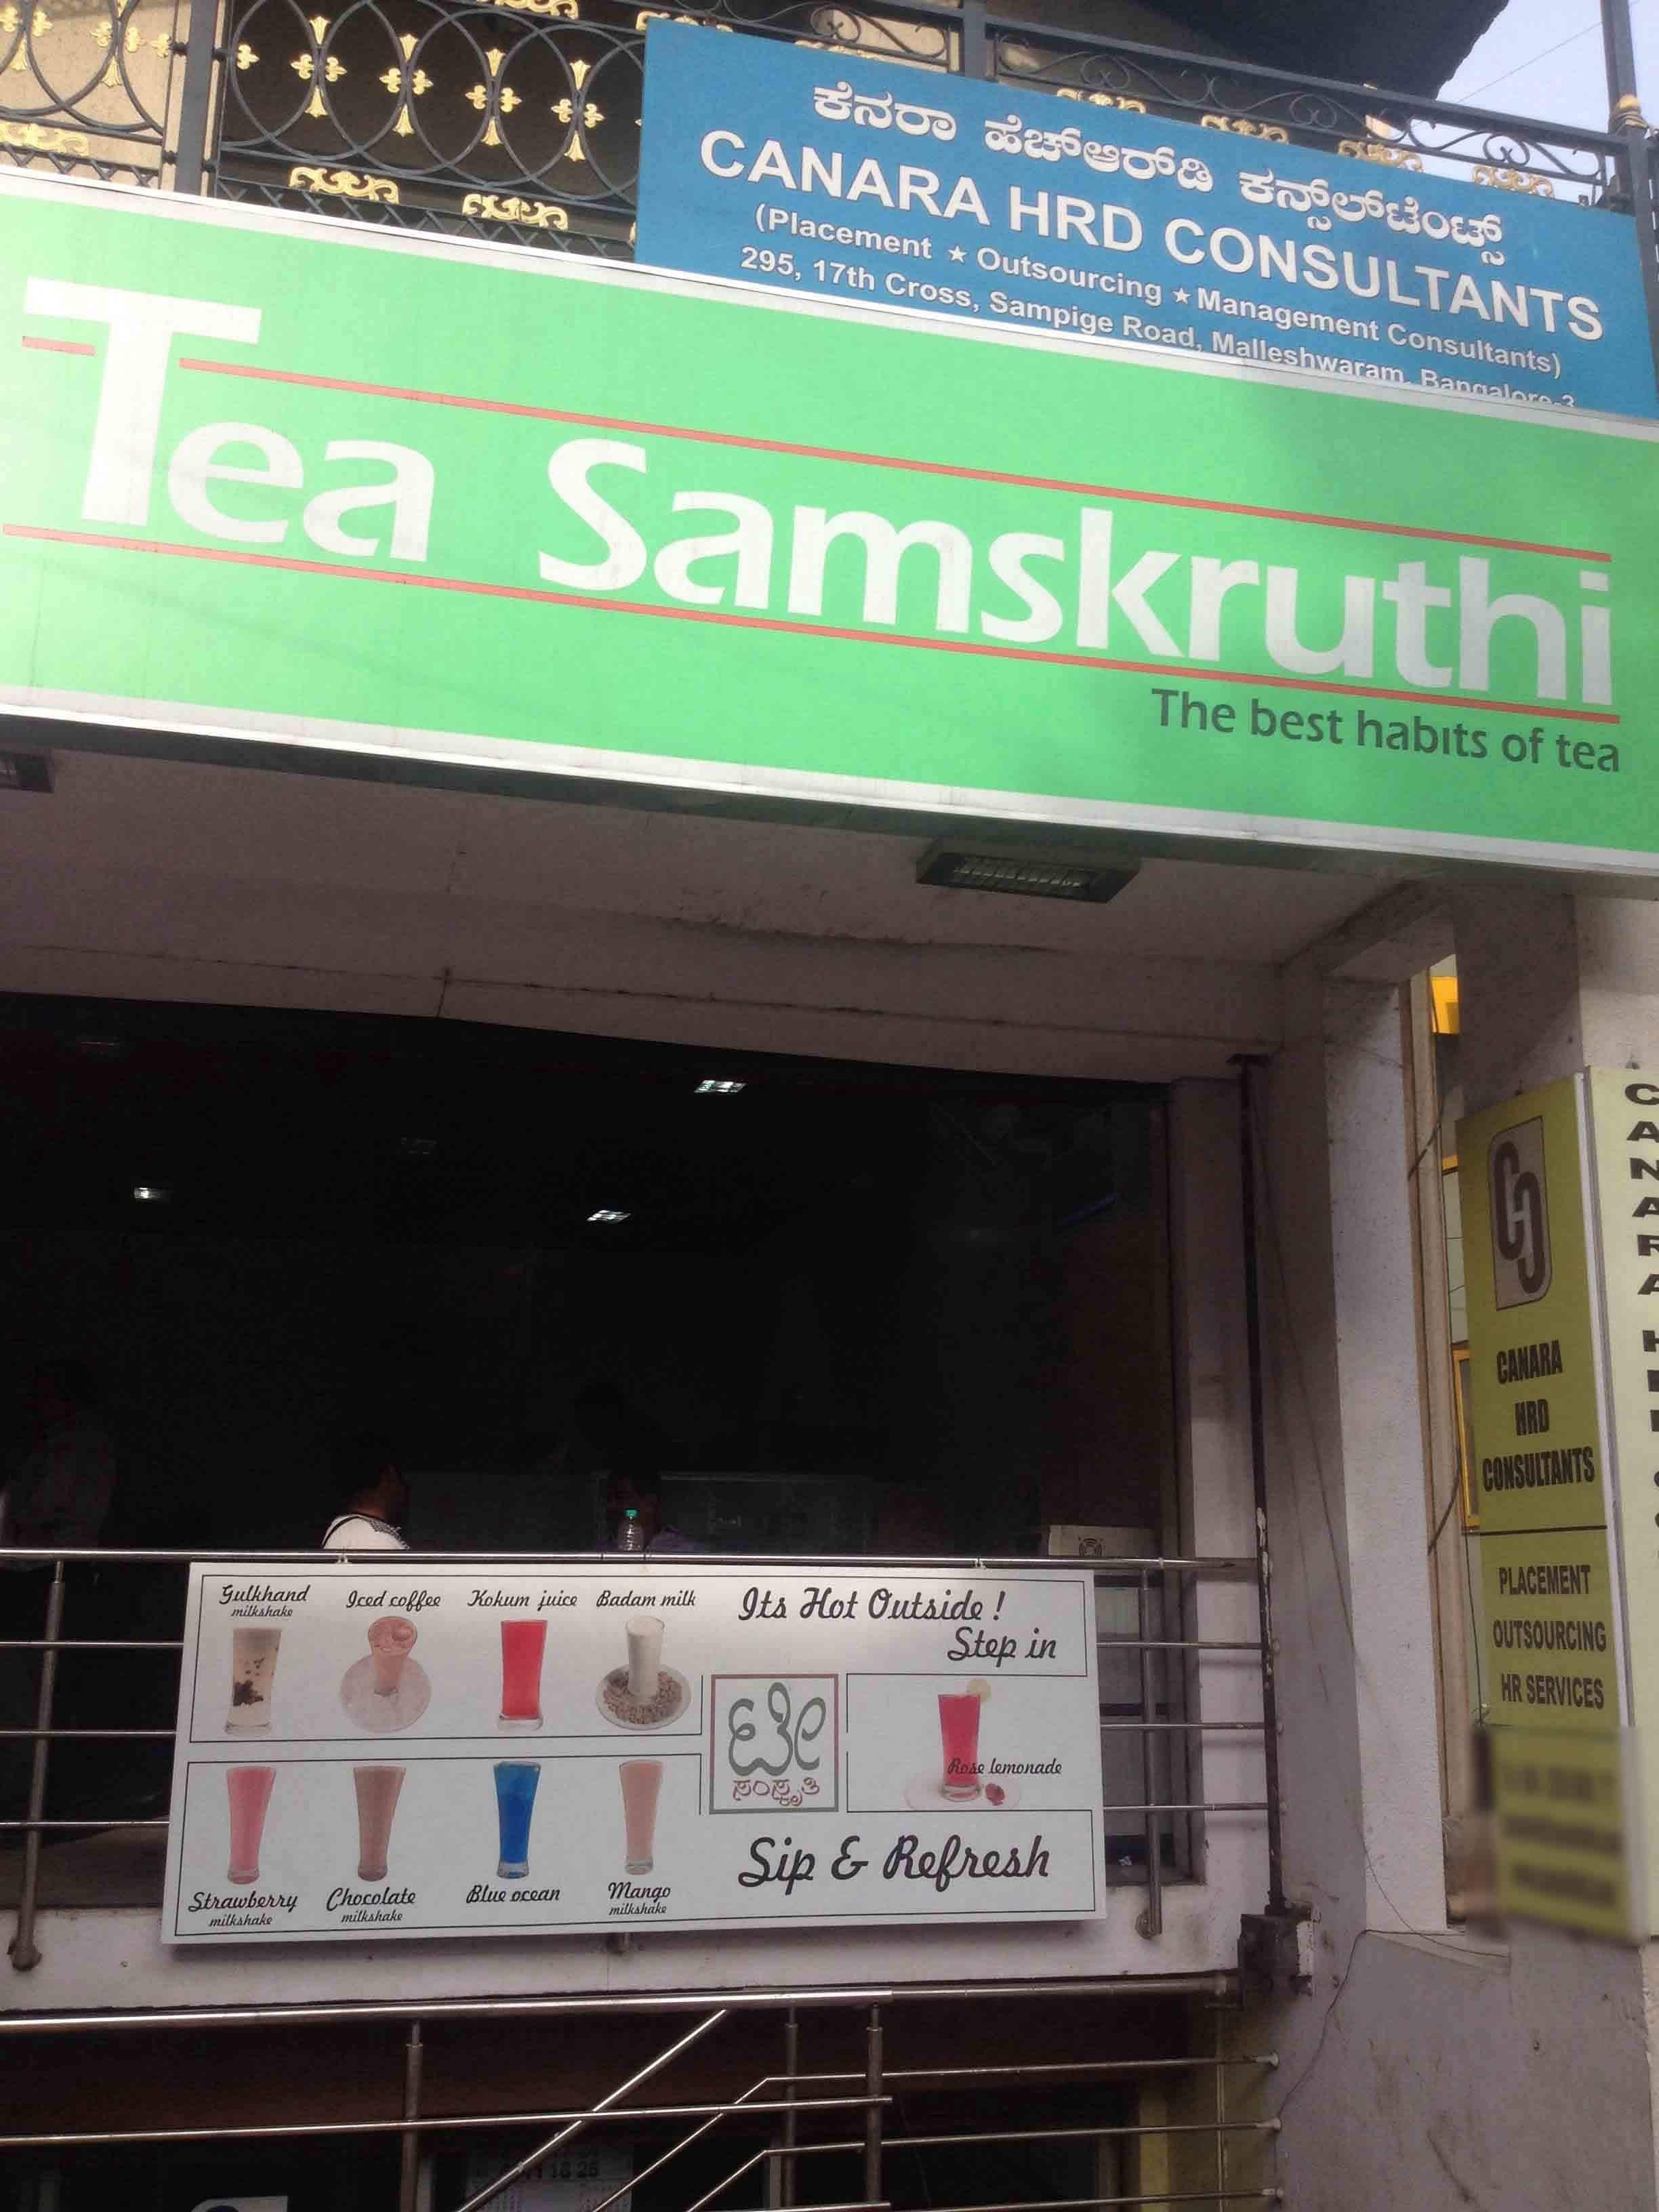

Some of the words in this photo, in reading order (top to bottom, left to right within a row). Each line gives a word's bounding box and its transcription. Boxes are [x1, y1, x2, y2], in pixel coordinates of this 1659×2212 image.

[813, 81, 958, 142] ಕೆನರಾ
[700, 129, 990, 226] CANARA
[1008, 186, 1143, 253] HRD
[1164, 218, 1603, 341] CONSULTANTS
[741, 246, 801, 282] 295,
[813, 260, 876, 291] 17th
[885, 272, 981, 314] Cross,
[989, 291, 1114, 335] Sampige
[1122, 314, 1204, 352] Road,
[754, 203, 933, 262] (Placement
[977, 247, 1161, 307] Outsourcing
[1197, 287, 1379, 341] Management
[1387, 323, 1561, 380] Consultants)
[23, 276, 436, 562] Tea
[539, 438, 1613, 706] Samskruthi
[1151, 688, 1236, 735] The
[1251, 697, 1344, 747] best
[1356, 709, 1487, 760] habits
[1501, 726, 1545, 764] of
[1556, 731, 1620, 773] tea
[1496, 1340, 1563, 1385] CANARA
[1515, 1399, 1550, 1437] HRD
[1482, 1446, 1595, 1492] CONSULTANTS
[220, 1584, 310, 1605] Gulkhand
[1498, 1565, 1591, 1595] PLACEMENT
[230, 1605, 293, 1618] milkshake
[346, 1590, 386, 1608] Iced
[389, 1589, 441, 1610] coffee
[468, 1589, 530, 1607] Kokum
[535, 1590, 577, 1612] juice
[596, 1590, 657, 1607] Badam
[659, 1589, 696, 1607] milk
[738, 1587, 787, 1621] Its
[800, 1587, 858, 1620] Hot
[868, 1588, 983, 1620] Outside
[947, 1626, 1017, 1668] Step
[1024, 1628, 1057, 1660] in
[1493, 1620, 1607, 1652] OUTSOURCING
[1501, 1673, 1522, 1702] HR
[1525, 1675, 1605, 1710] SERVICES
[948, 1758, 985, 1774] Rose
[989, 1758, 1062, 1775] lemonade
[738, 1837, 815, 1896] Sip
[831, 1835, 869, 1881] &
[883, 1834, 1049, 1893] Refresh
[188, 1891, 298, 1913] Strawberry
[327, 1887, 416, 1909] Chocolate
[466, 1885, 507, 1903] Blue
[510, 1886, 560, 1902] ocean
[608, 1881, 671, 1903] Mango
[209, 1913, 272, 1927] milkshake
[341, 1910, 403, 1923] milkshake
[608, 1903, 667, 1917] milkshake
